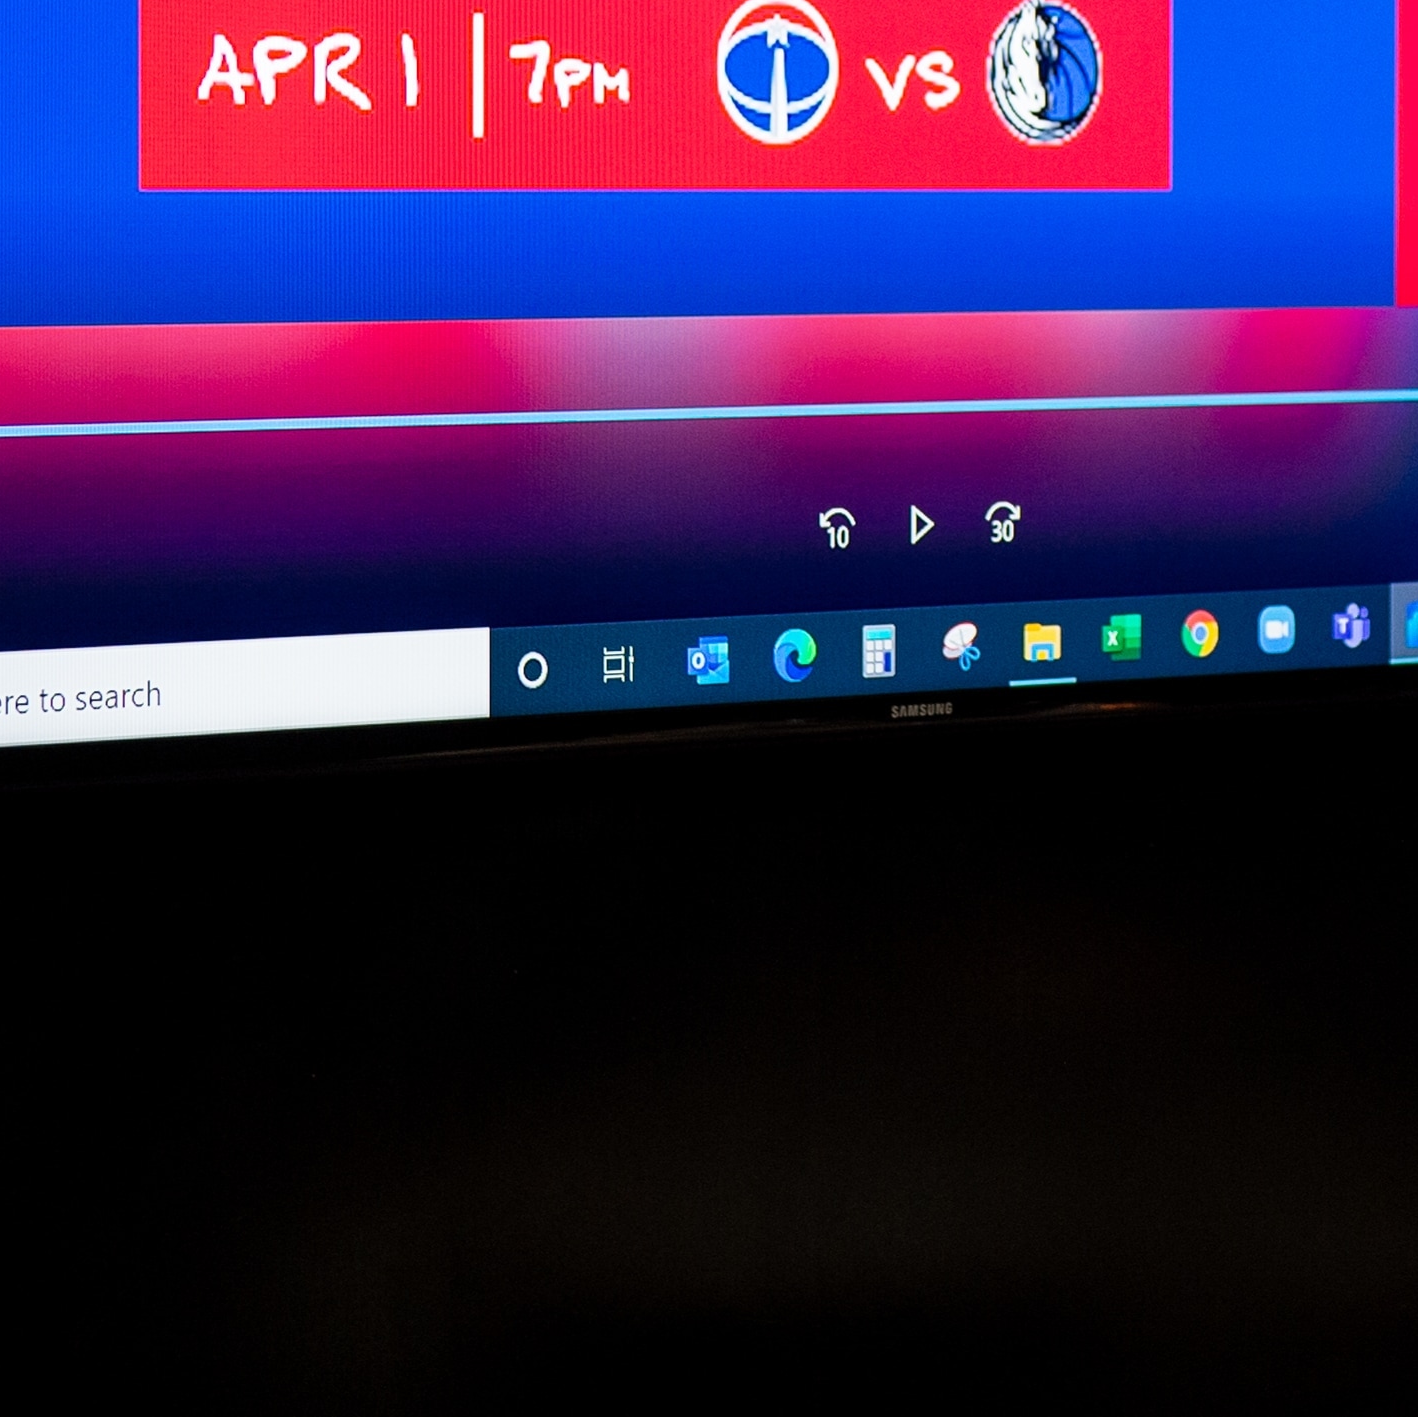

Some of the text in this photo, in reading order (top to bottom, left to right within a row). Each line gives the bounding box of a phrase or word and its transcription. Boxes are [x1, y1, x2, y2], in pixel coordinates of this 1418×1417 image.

[197, 33, 372, 111] APR
[509, 40, 630, 109] 7PM
[865, 51, 961, 112] VS
[827, 526, 850, 549] 10
[990, 519, 1015, 543] 30
[39, 688, 66, 713] to
[75, 680, 162, 711] search
[891, 701, 954, 719] SAMSUNG
